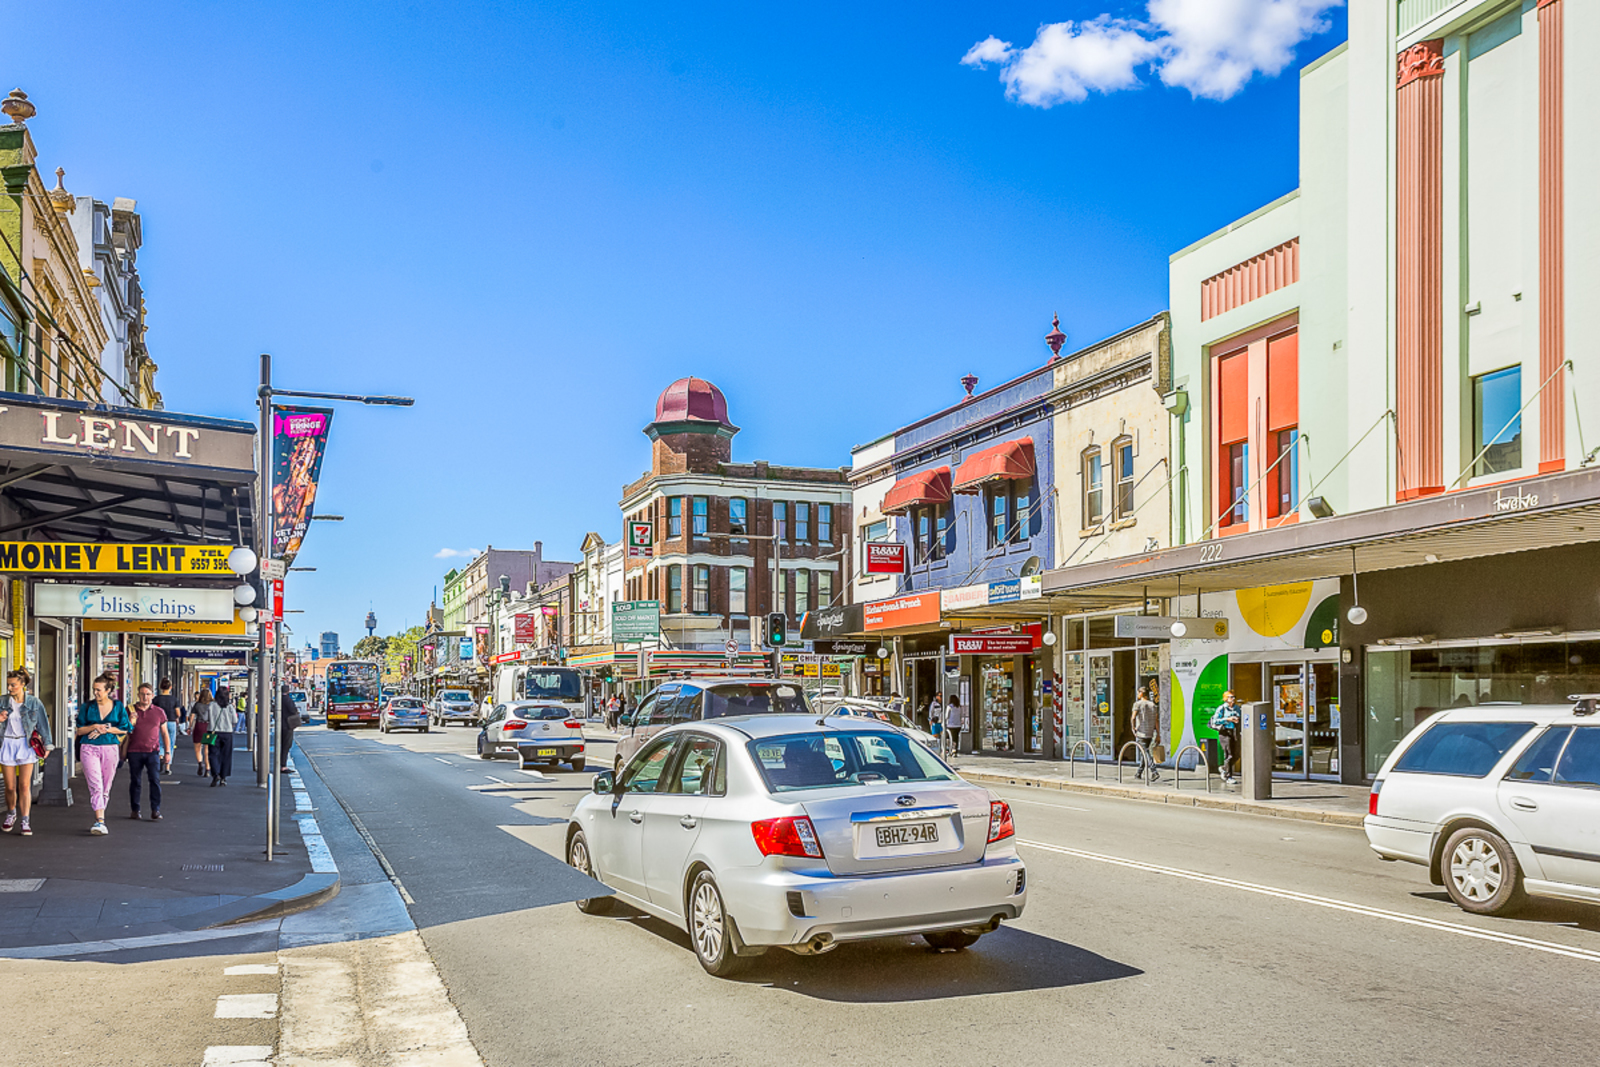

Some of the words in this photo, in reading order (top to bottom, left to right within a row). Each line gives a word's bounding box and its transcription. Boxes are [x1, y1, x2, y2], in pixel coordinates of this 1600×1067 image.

[290, 421, 321, 430] FRINGE
[39, 410, 200, 458] LENT
[1493, 486, 1539, 511] twelve
[0, 544, 102, 570] MONEY
[117, 546, 186, 571] LENT
[199, 549, 225, 557] TEL
[870, 546, 902, 556] R&W
[1200, 544, 1223, 563] 222
[190, 557, 210, 571] 9557
[948, 590, 984, 604] BARBER
[101, 596, 139, 613] bliss
[150, 599, 196, 618] chips
[1215, 625, 1226, 633] 218
[957, 640, 983, 650] R&W
[823, 665, 838, 673] 5.50
